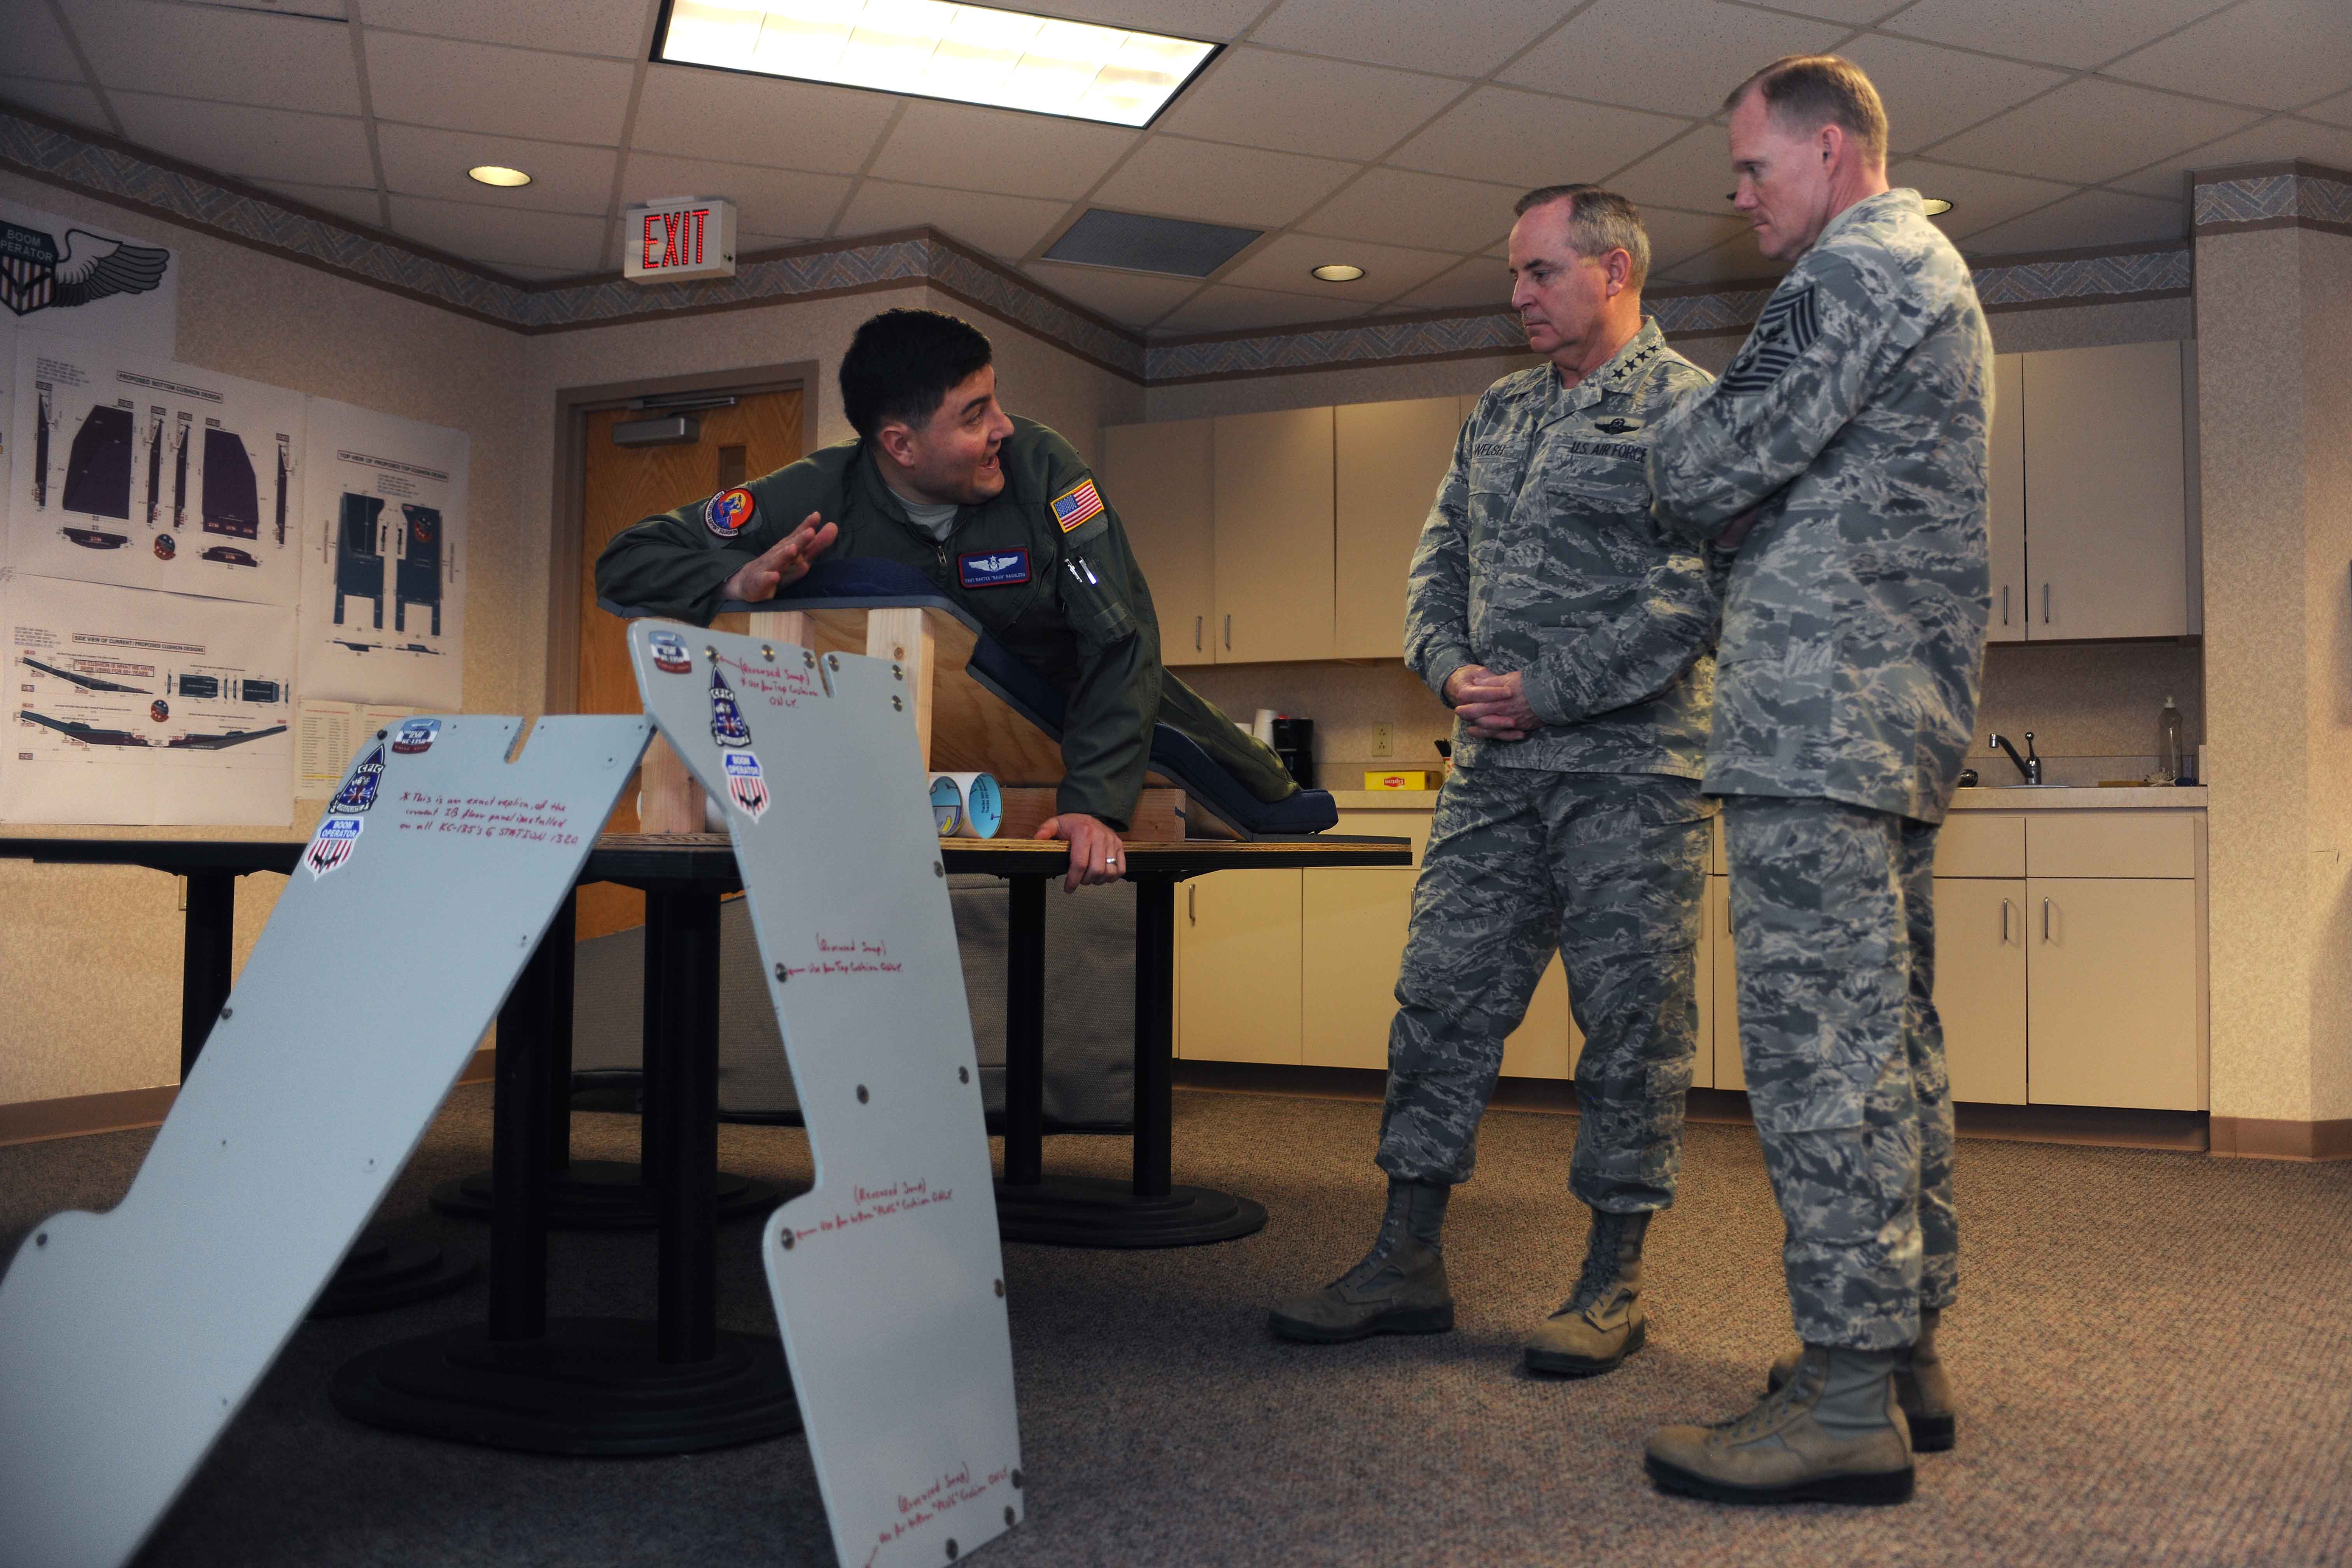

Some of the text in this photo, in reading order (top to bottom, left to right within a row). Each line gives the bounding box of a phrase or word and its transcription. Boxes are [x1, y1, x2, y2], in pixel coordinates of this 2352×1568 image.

[7, 229, 41, 247] BOOM
[643, 209, 709, 269] EXIT
[0, 240, 53, 262] PERATOR
[1474, 444, 1506, 456] WELSH
[1570, 441, 1648, 463] U.S. AIR FORCE
[359, 765, 383, 773] CFIC
[732, 756, 751, 765] BOOM
[413, 793, 431, 803] This
[467, 797, 495, 805] exact
[550, 802, 566, 811] the
[321, 829, 357, 838] OPERATOR
[333, 821, 354, 829] BOOM
[416, 820, 433, 830] all
[498, 828, 547, 842] STATION
